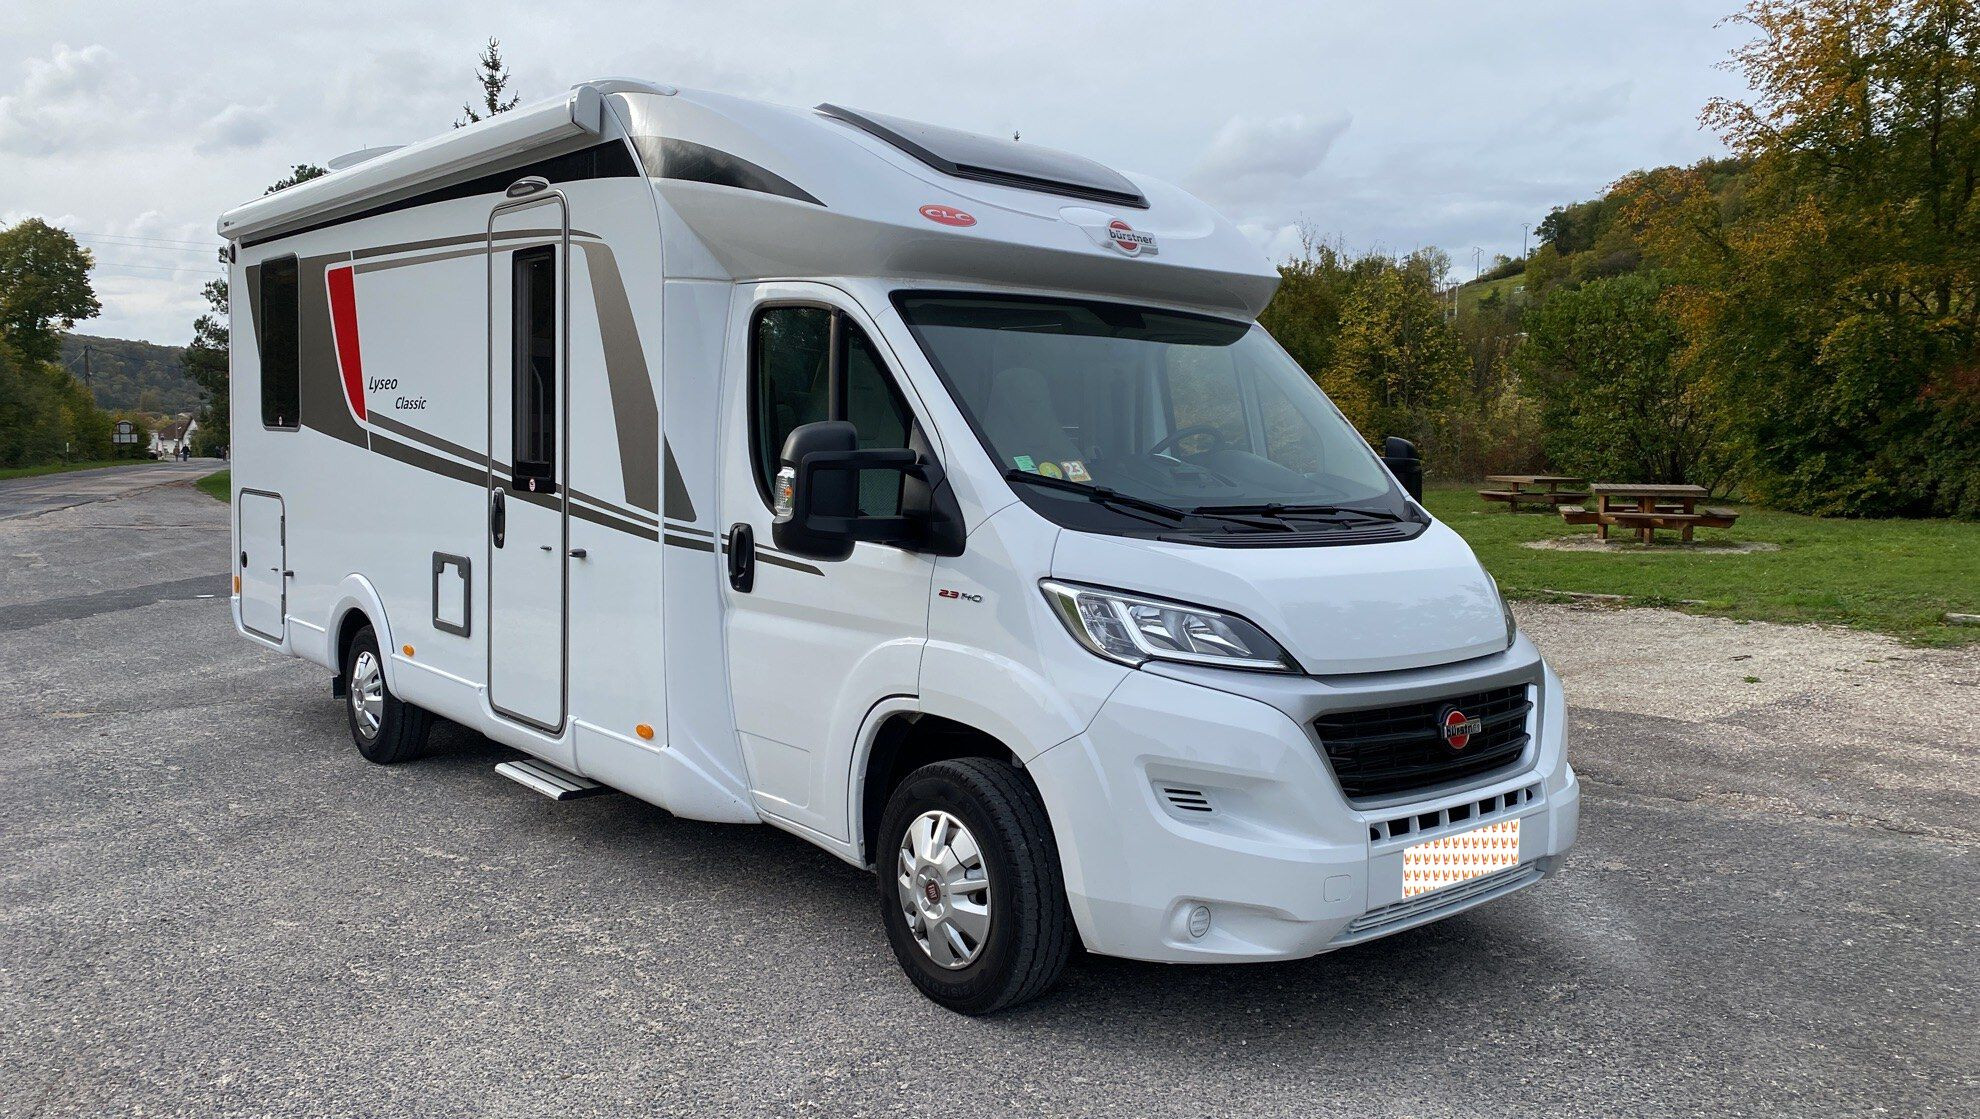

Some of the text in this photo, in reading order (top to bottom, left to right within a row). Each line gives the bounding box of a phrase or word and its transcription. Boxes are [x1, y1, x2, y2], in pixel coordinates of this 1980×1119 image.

[925, 209, 971, 221] CLC
[1108, 228, 1153, 244] bürstner
[369, 376, 398, 393] Lyseo
[395, 396, 427, 410] Classic
